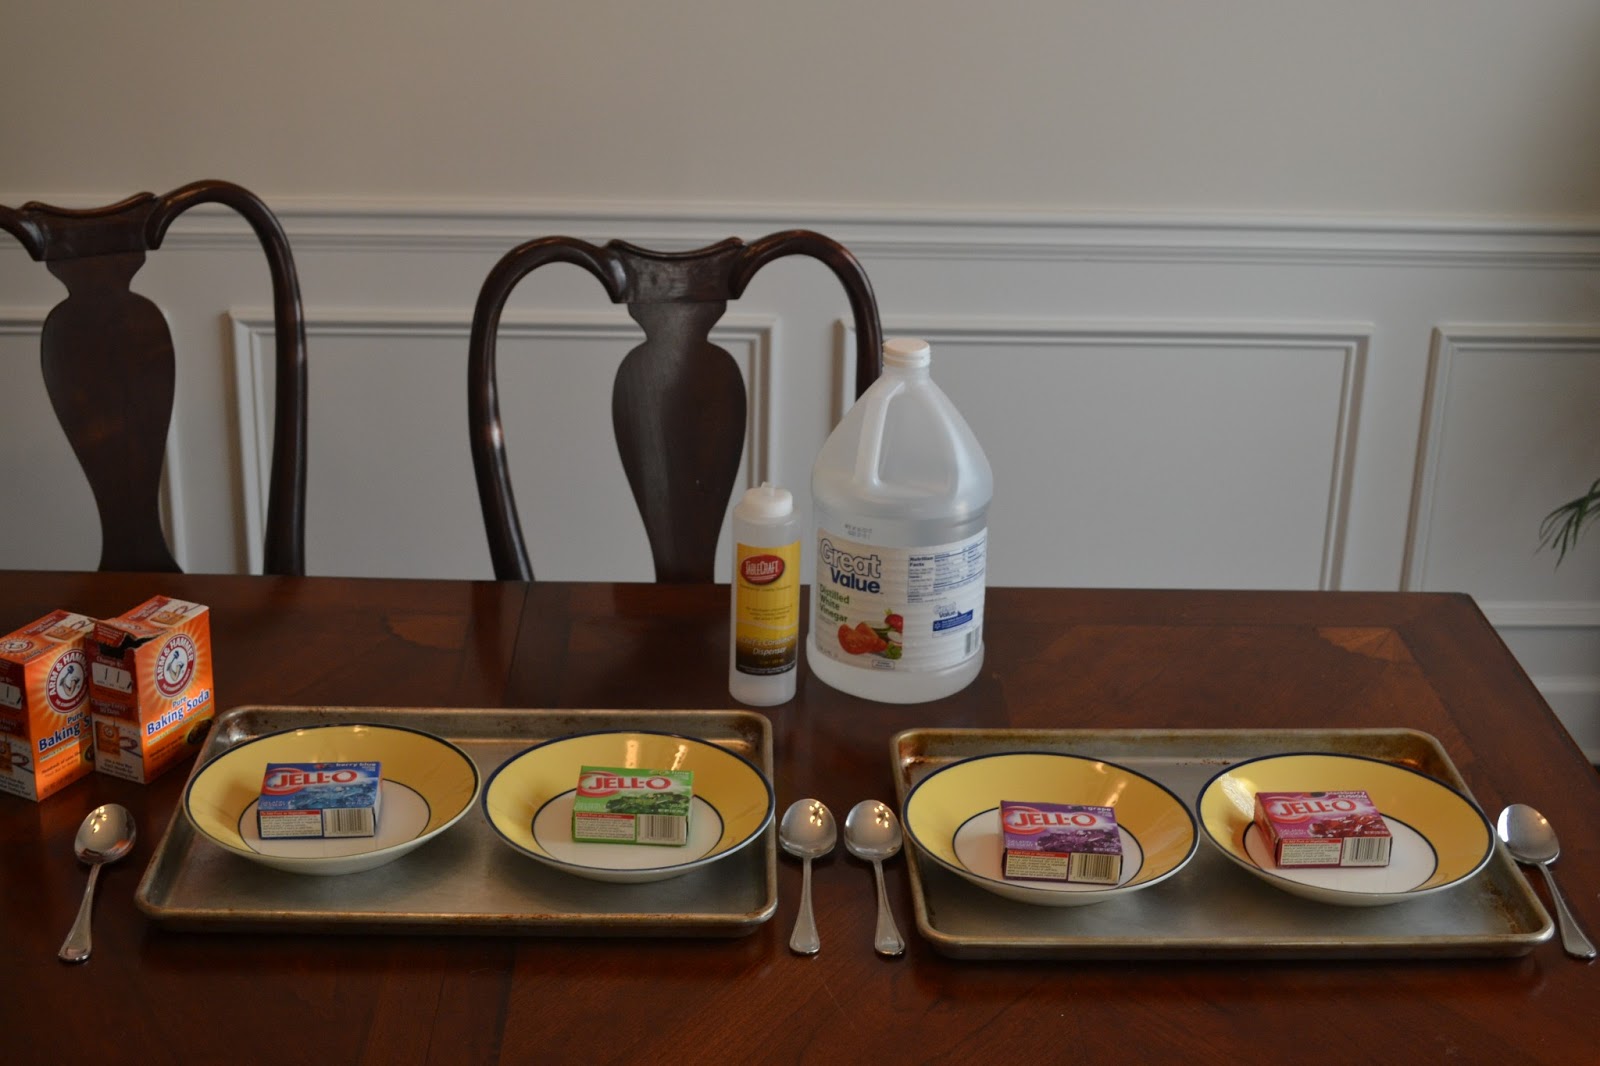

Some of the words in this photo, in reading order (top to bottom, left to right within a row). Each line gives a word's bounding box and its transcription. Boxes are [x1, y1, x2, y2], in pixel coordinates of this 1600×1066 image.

[820, 538, 881, 578] Great
[830, 566, 880, 594] Value
[819, 584, 850, 605] Distilled
[819, 595, 840, 611] White
[819, 603, 849, 623] Vinegar
[157, 655, 166, 681] ARM
[169, 637, 194, 662] HAMMER
[48, 670, 58, 696] ARM
[147, 707, 184, 735] Baking
[187, 689, 210, 712] Soda
[172, 696, 187, 708] Pure
[67, 710, 84, 724] Pure
[38, 722, 81, 751] Baking
[273, 769, 357, 788] JELL-O
[588, 776, 671, 790] JELL-O
[1280, 799, 1356, 817] JELL-O
[1014, 812, 1097, 827] JELL-O
